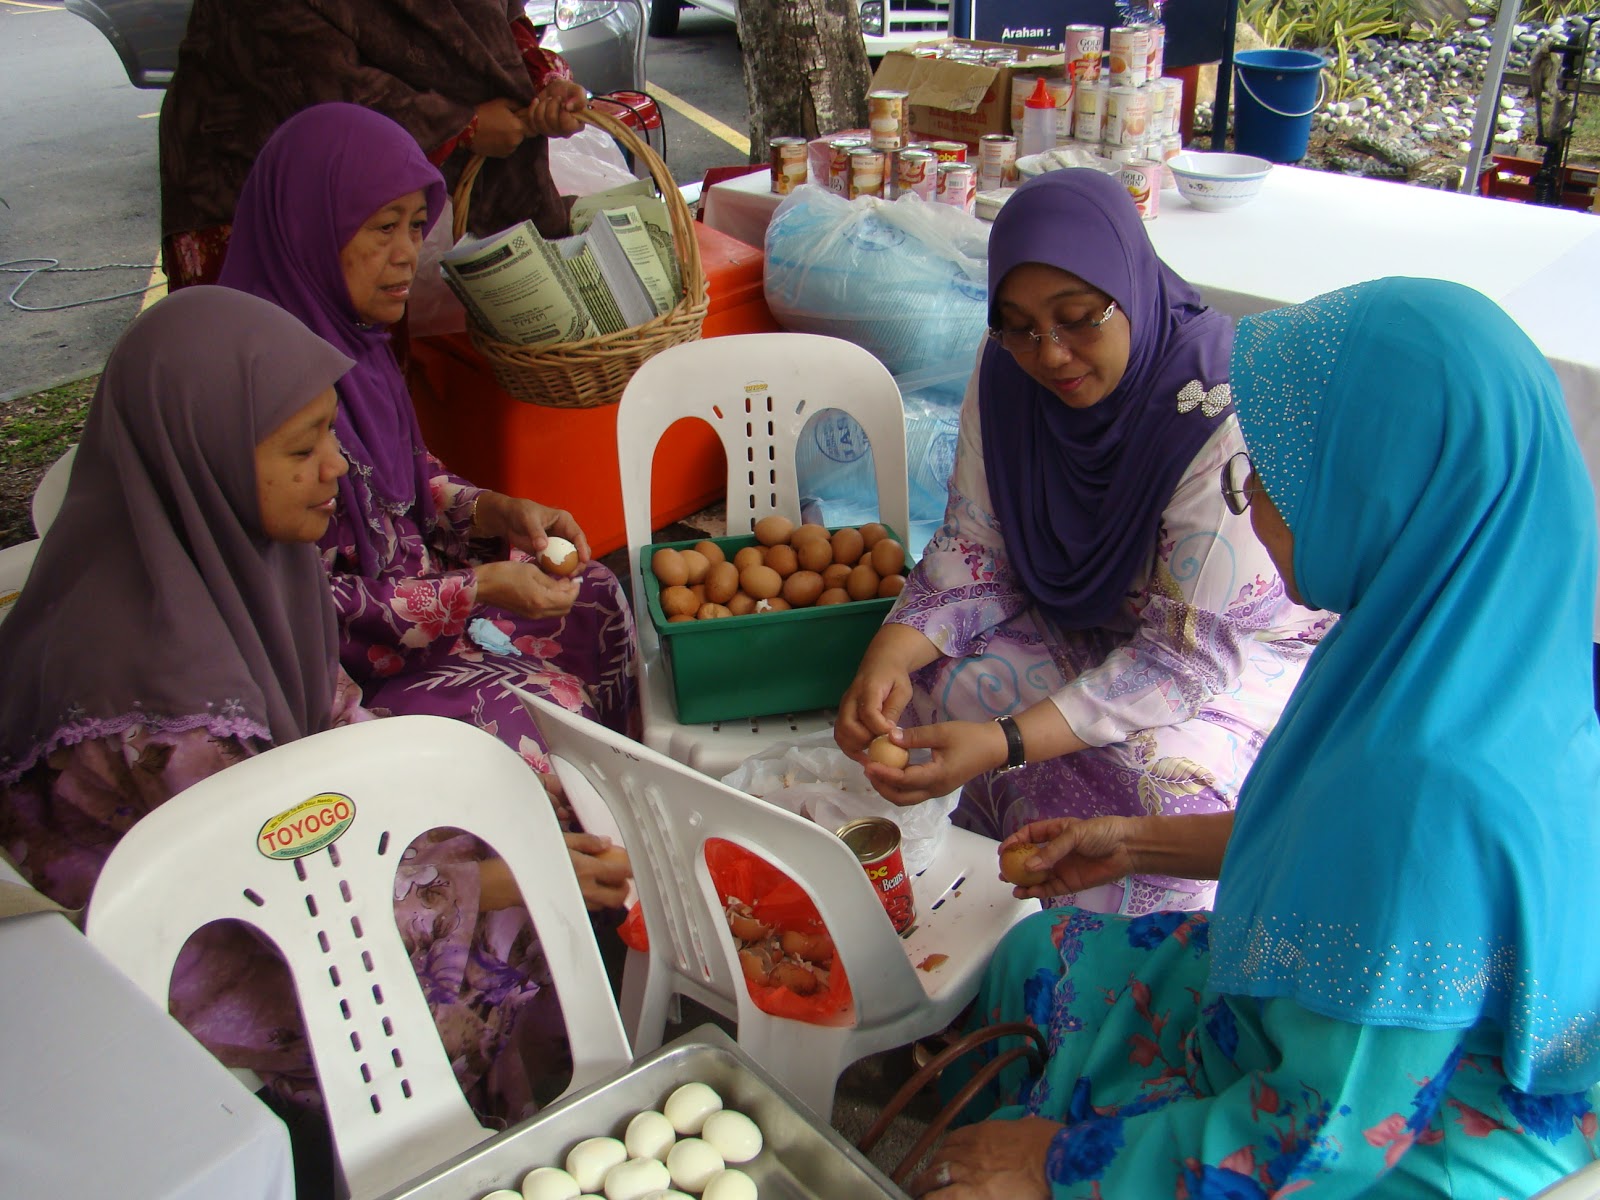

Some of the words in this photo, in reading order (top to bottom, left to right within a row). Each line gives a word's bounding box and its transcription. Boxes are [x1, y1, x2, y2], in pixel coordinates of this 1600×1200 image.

[1002, 27, 1044, 39] Arahan
[1080, 38, 1101, 46] GOLD
[1122, 171, 1144, 181] GOLD
[1123, 179, 1141, 187] COIN
[263, 801, 350, 851] TOYOGO
[865, 865, 889, 881] bc
[882, 870, 904, 892] Beans
